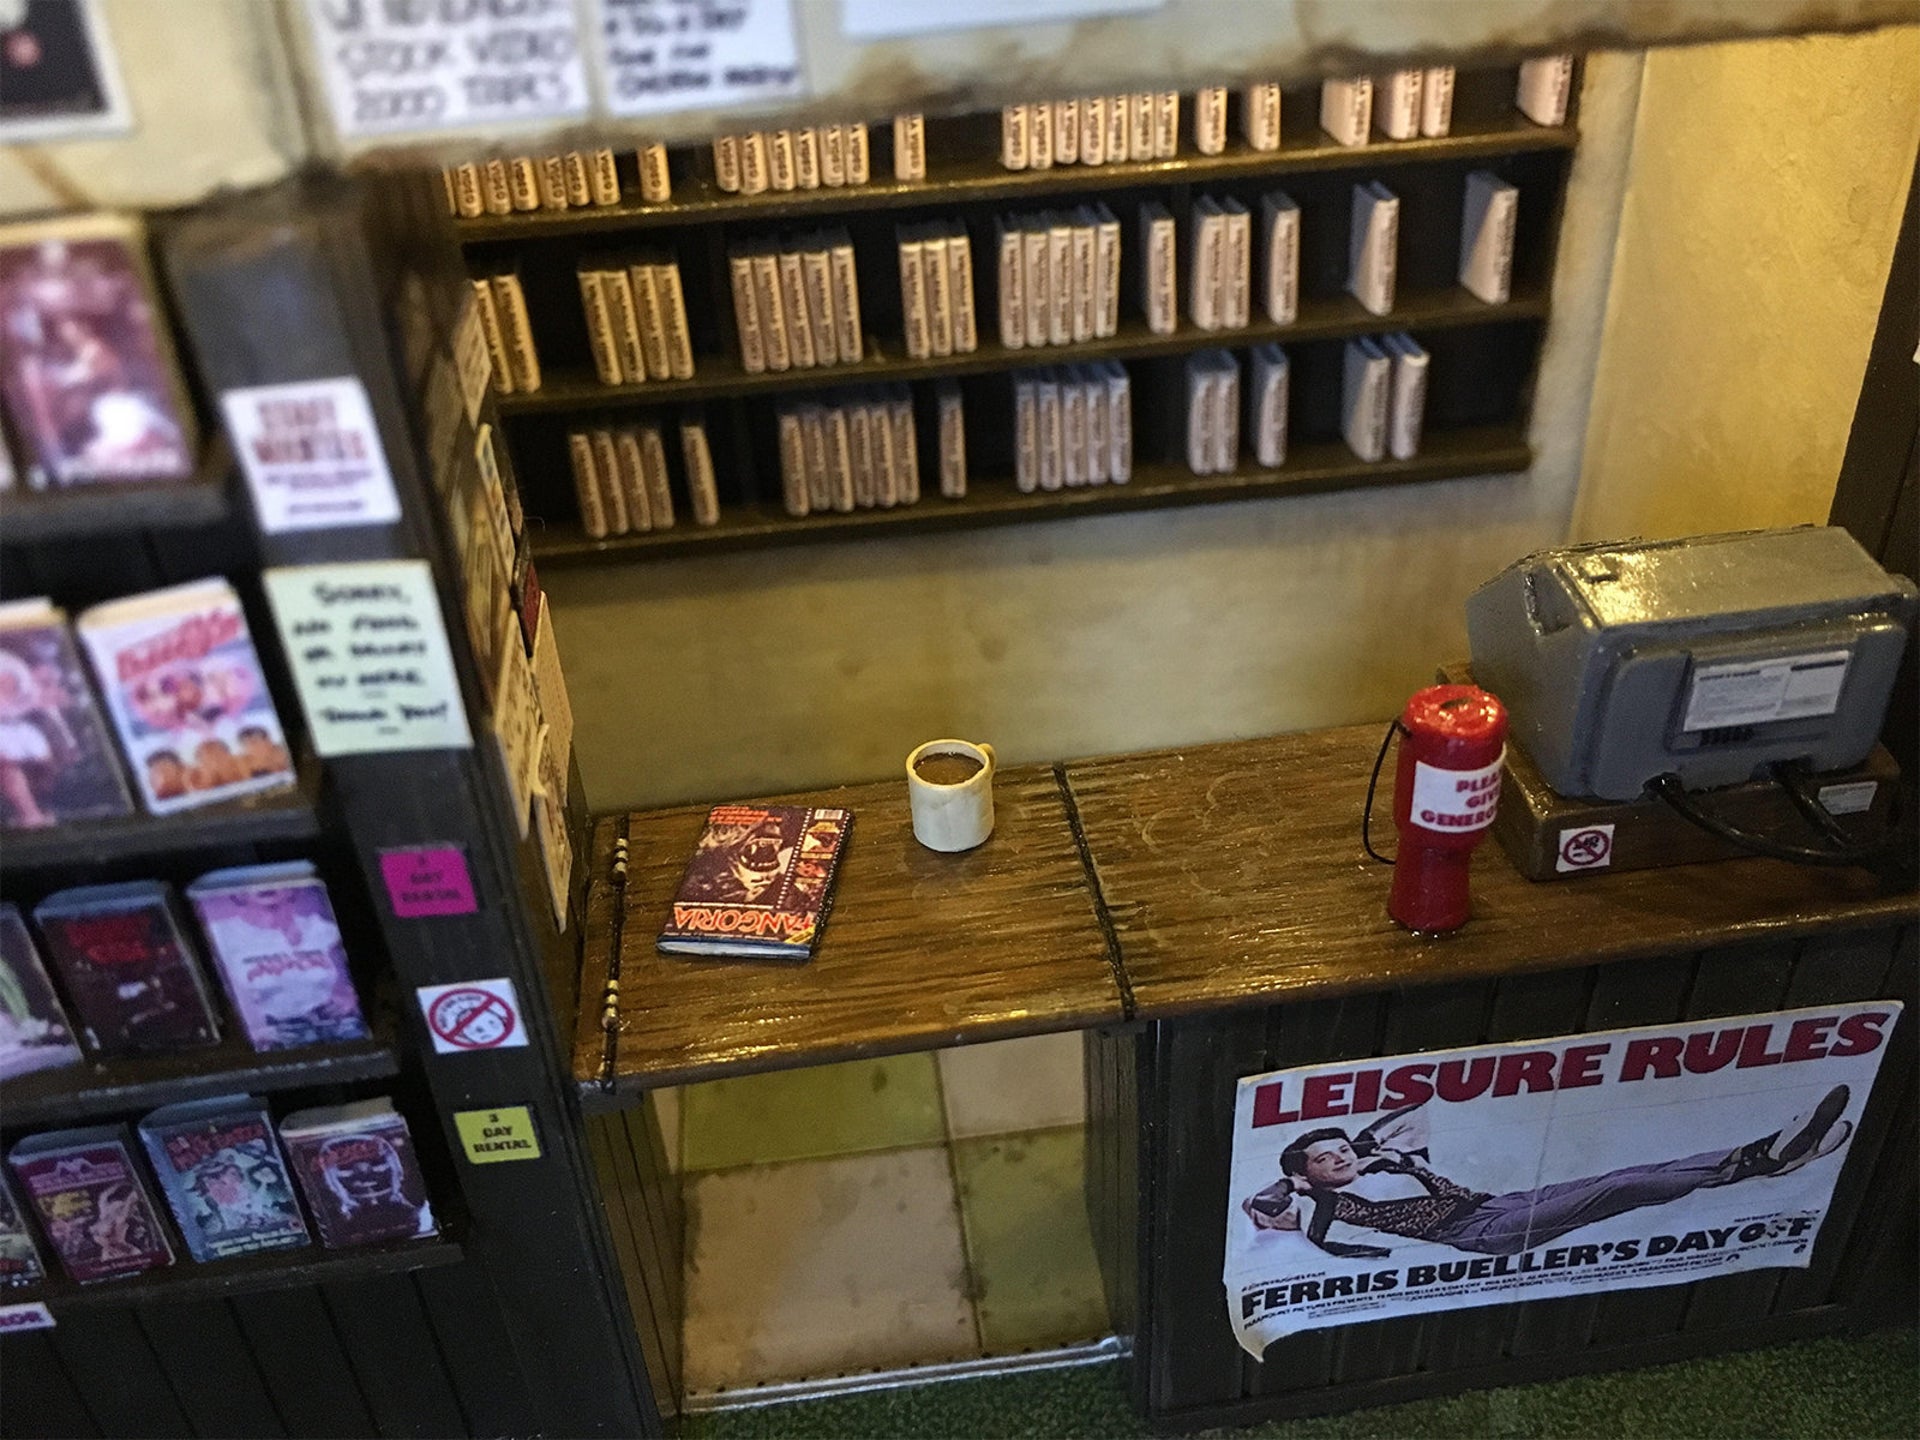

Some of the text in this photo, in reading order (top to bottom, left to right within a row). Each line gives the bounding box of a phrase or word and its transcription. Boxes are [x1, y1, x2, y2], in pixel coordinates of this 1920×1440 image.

[673, 907, 814, 936] FANGORIA
[1251, 1012, 1892, 1129] LEISURE RULES
[473, 1139, 532, 1153] RENTAL
[482, 1126, 513, 1138] DAY
[1242, 1269, 1399, 1320] FERRIS
[1405, 1239, 1642, 1288] BUELLER'S
[1646, 1226, 1740, 1258] DAY
